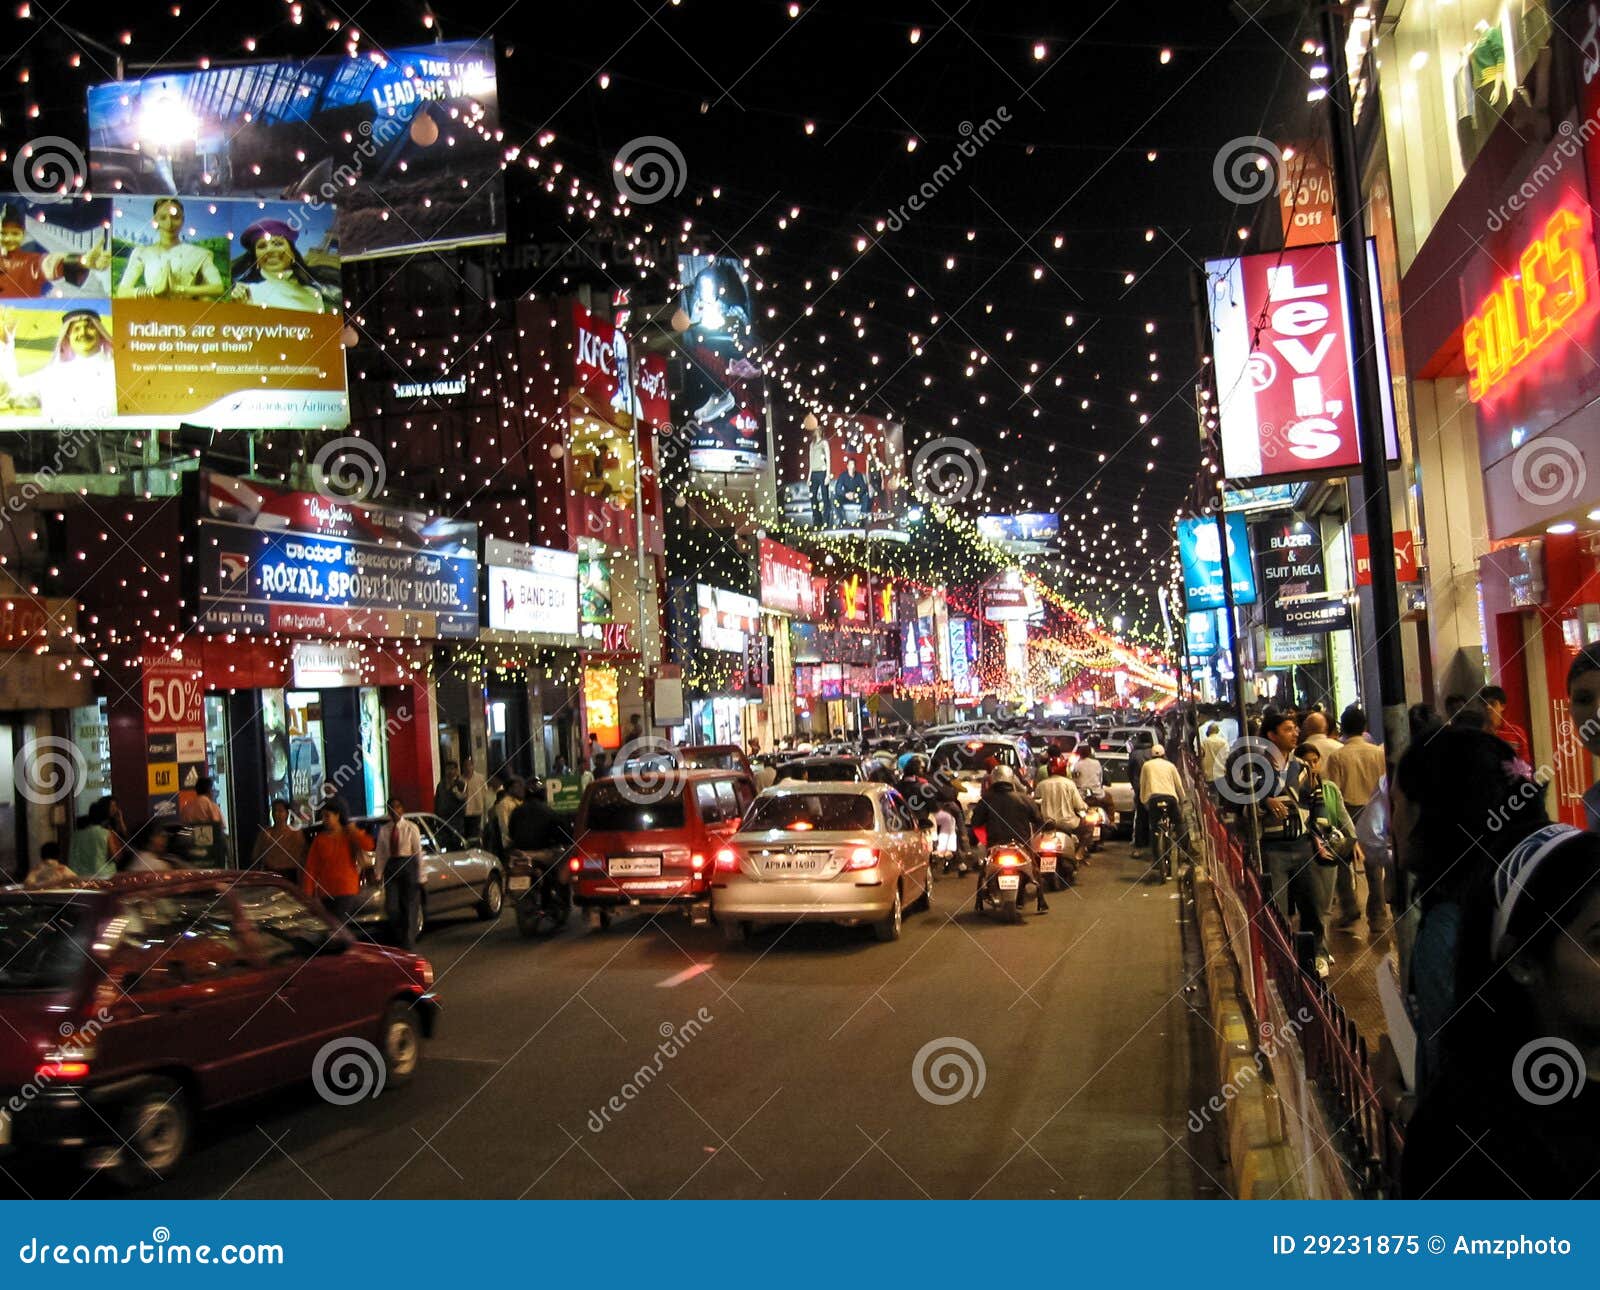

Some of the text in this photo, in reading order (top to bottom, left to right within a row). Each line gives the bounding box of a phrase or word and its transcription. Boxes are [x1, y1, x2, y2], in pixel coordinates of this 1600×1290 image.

[420, 60, 450, 76] TAKE
[372, 80, 415, 109] LEAD
[1464, 207, 1587, 402] SOLES
[129, 322, 314, 341] Indians are everywhere.
[131, 341, 253, 353] How do they get them?
[577, 327, 611, 375] KFC
[395, 383, 423, 398] SERVE
[432, 380, 466, 395] VOLLEY
[302, 399, 341, 412] Airlines
[1270, 533, 1312, 548] BLAZER
[1287, 550, 1296, 562] &
[1265, 564, 1321, 579] SUIT MELA
[261, 564, 460, 605] ROYAL SPORTING HOUSE
[1286, 607, 1346, 621] DOCKERS
[950, 620, 970, 693] SONY
[147, 677, 202, 723] 50%
